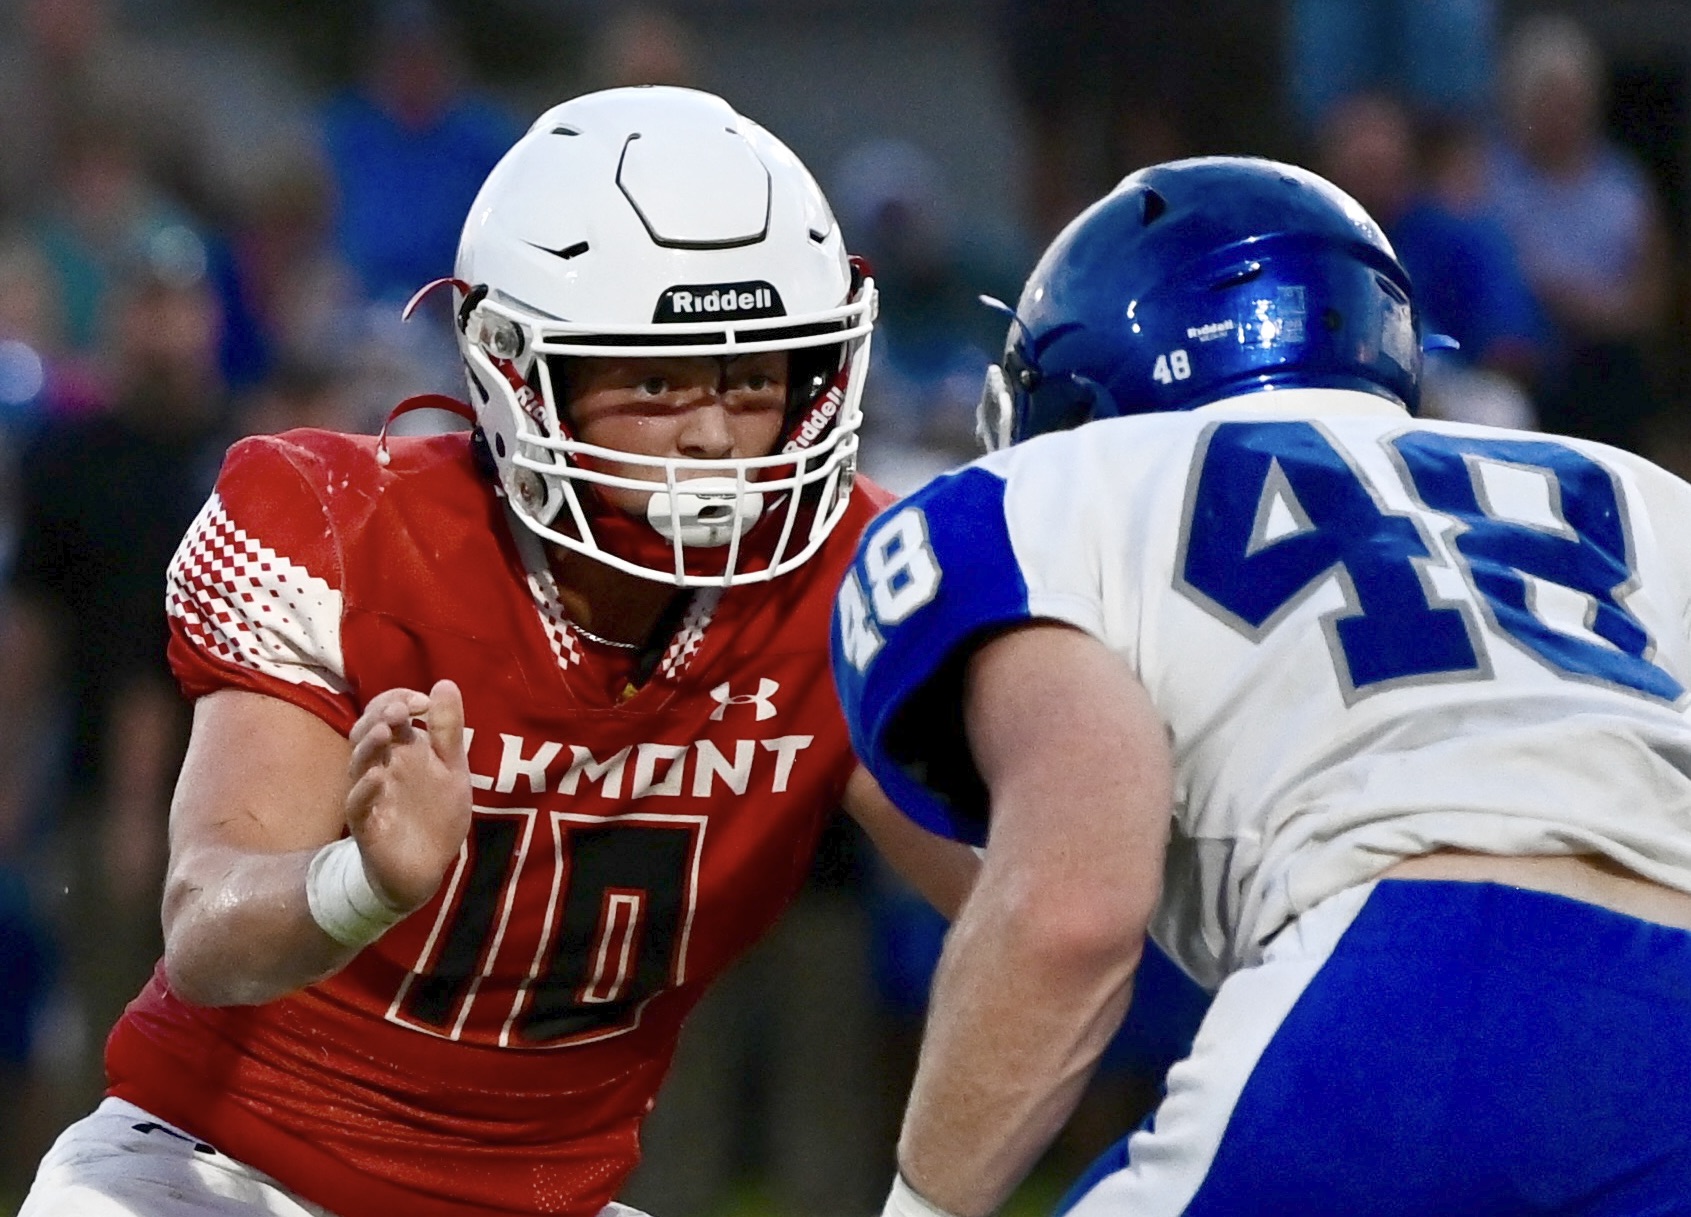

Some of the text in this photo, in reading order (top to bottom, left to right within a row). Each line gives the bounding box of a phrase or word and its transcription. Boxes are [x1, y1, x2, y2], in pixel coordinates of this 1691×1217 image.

[672, 288, 772, 313] Riddell
[1152, 349, 1192, 385] 48
[782, 386, 844, 454] Riddell
[837, 506, 943, 677] 48
[1171, 419, 1691, 712] 48
[463, 727, 815, 799] LKMONT
[384, 805, 709, 1049] 10
